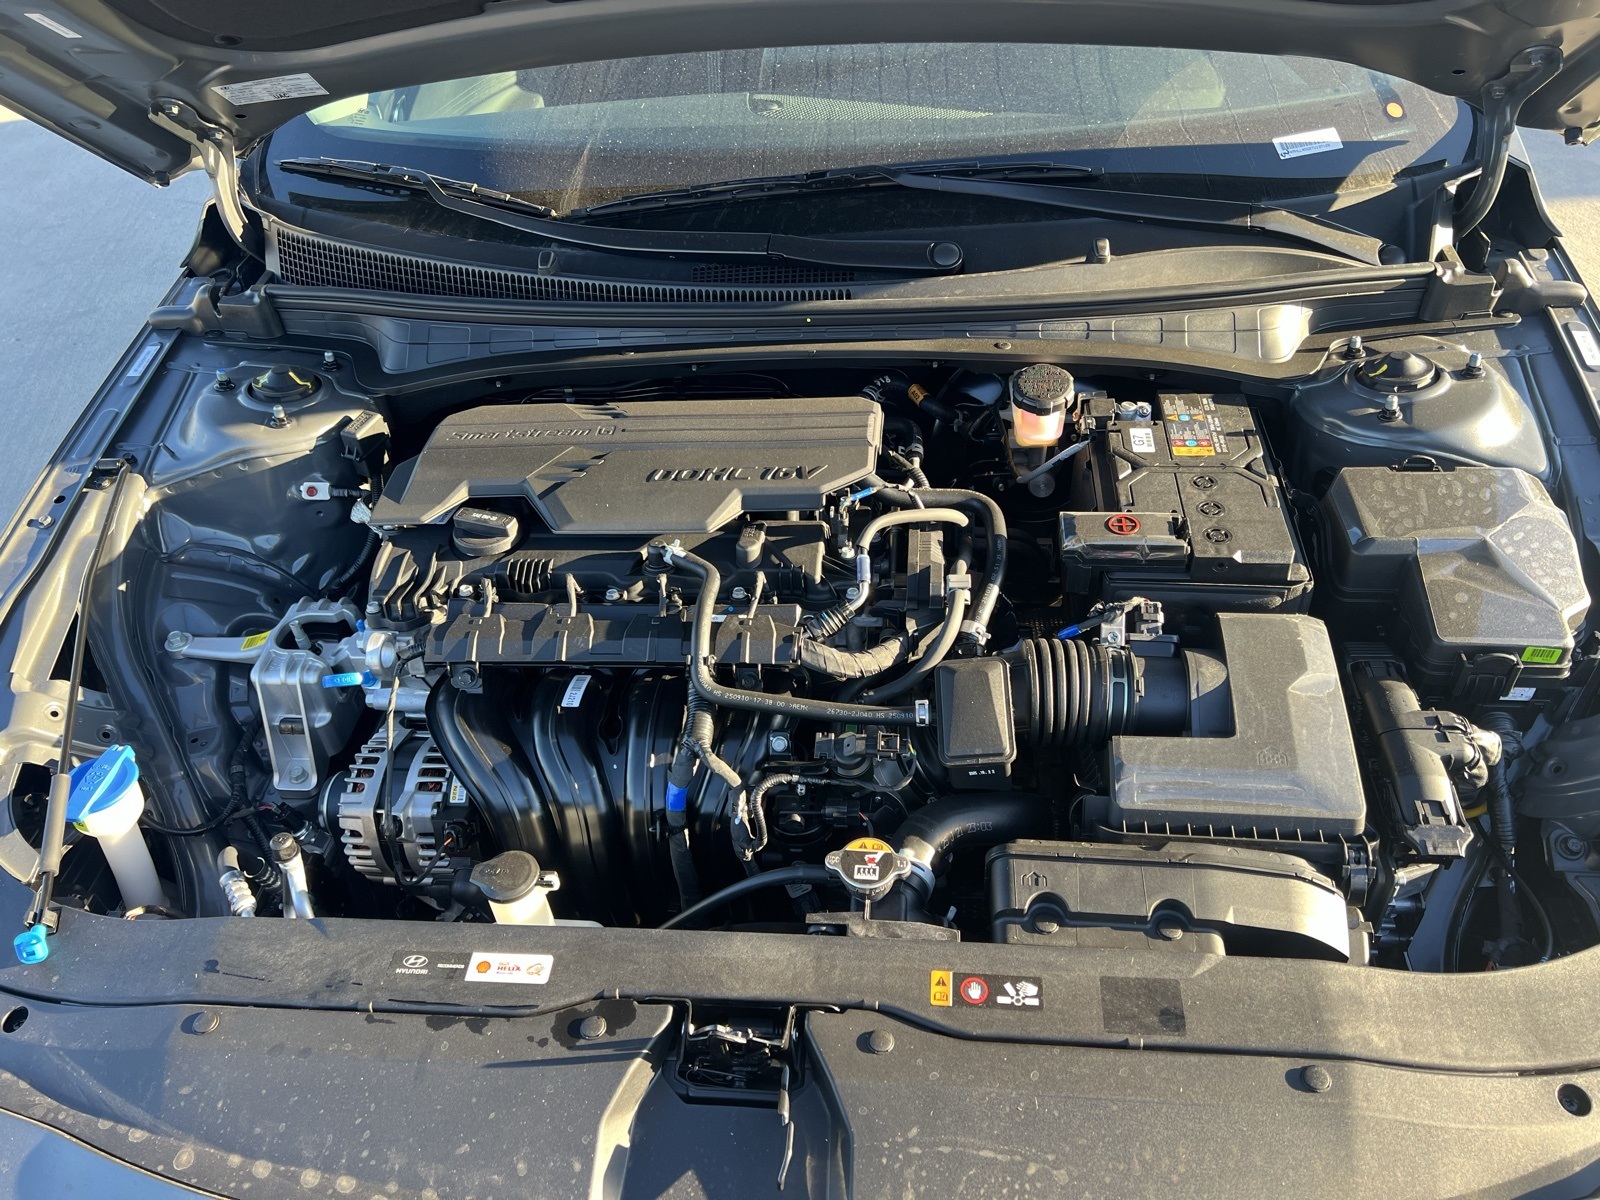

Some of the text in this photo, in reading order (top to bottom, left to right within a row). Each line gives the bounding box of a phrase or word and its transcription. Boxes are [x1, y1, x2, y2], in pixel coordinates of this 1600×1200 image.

[451, 427, 592, 440] Smartstream
[1132, 434, 1145, 446] G7
[645, 464, 829, 483] DOHC 16V
[712, 689, 722, 697] HS
[826, 708, 873, 718] 26730-2J040
[496, 964, 522, 972] HELIX
